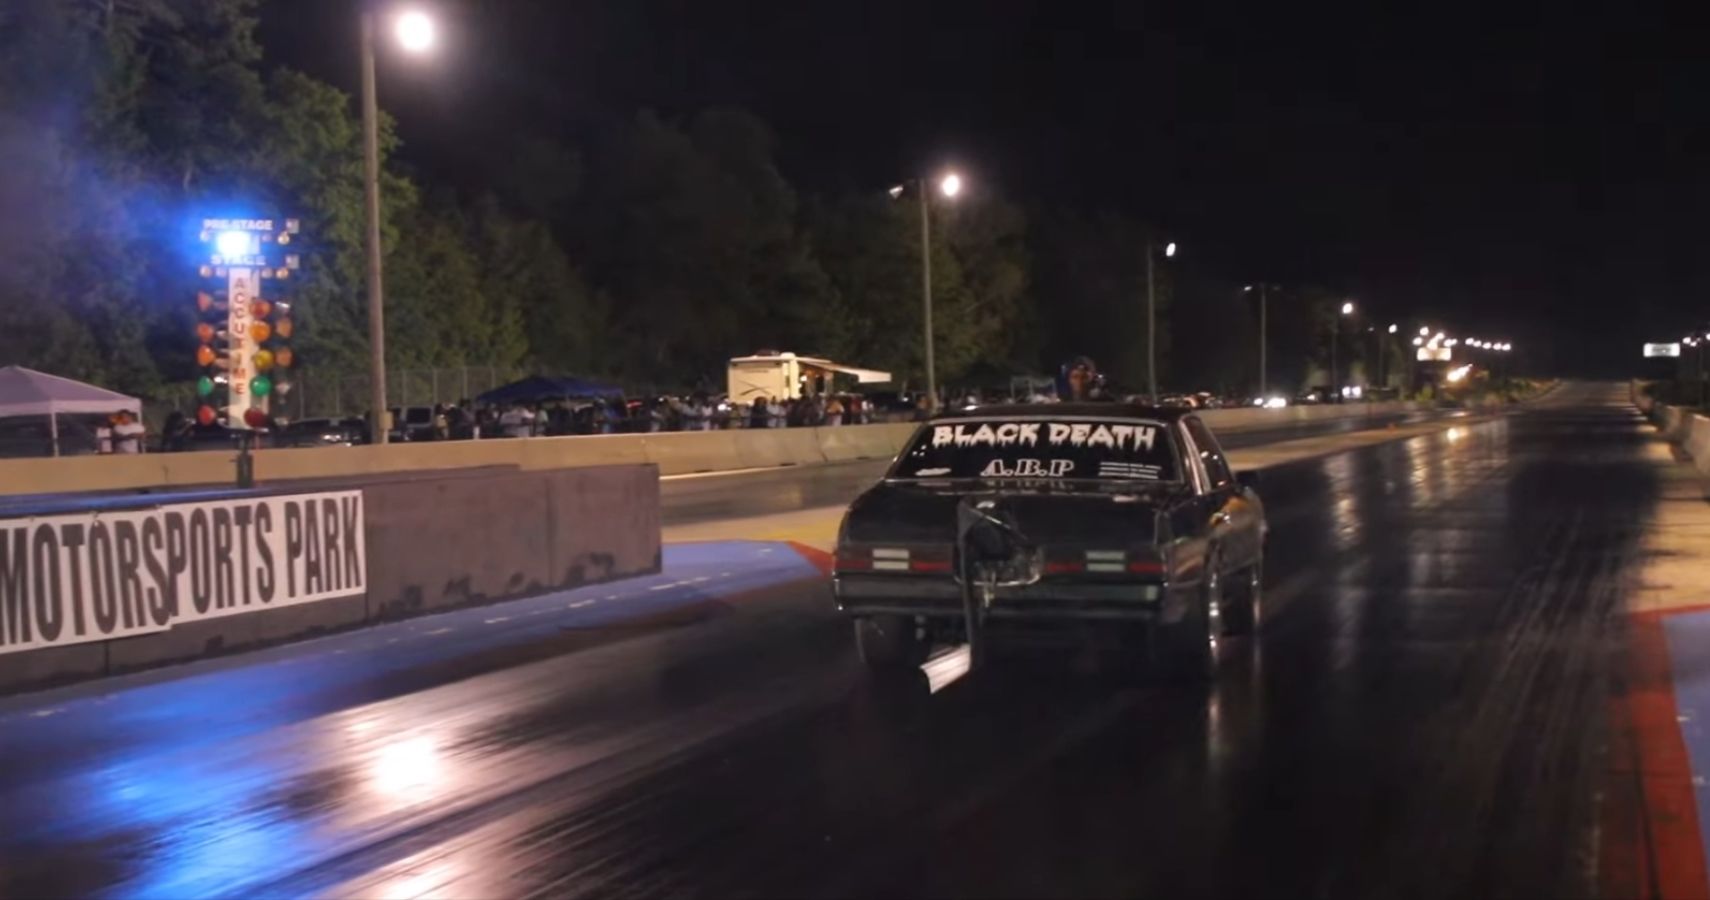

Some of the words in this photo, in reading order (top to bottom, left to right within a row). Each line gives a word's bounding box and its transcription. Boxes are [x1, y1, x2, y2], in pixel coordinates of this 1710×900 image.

[231, 219, 273, 231] STAGE
[932, 423, 1040, 448] BLACK
[1048, 423, 1156, 450] DEATH
[284, 496, 363, 598] PARK
